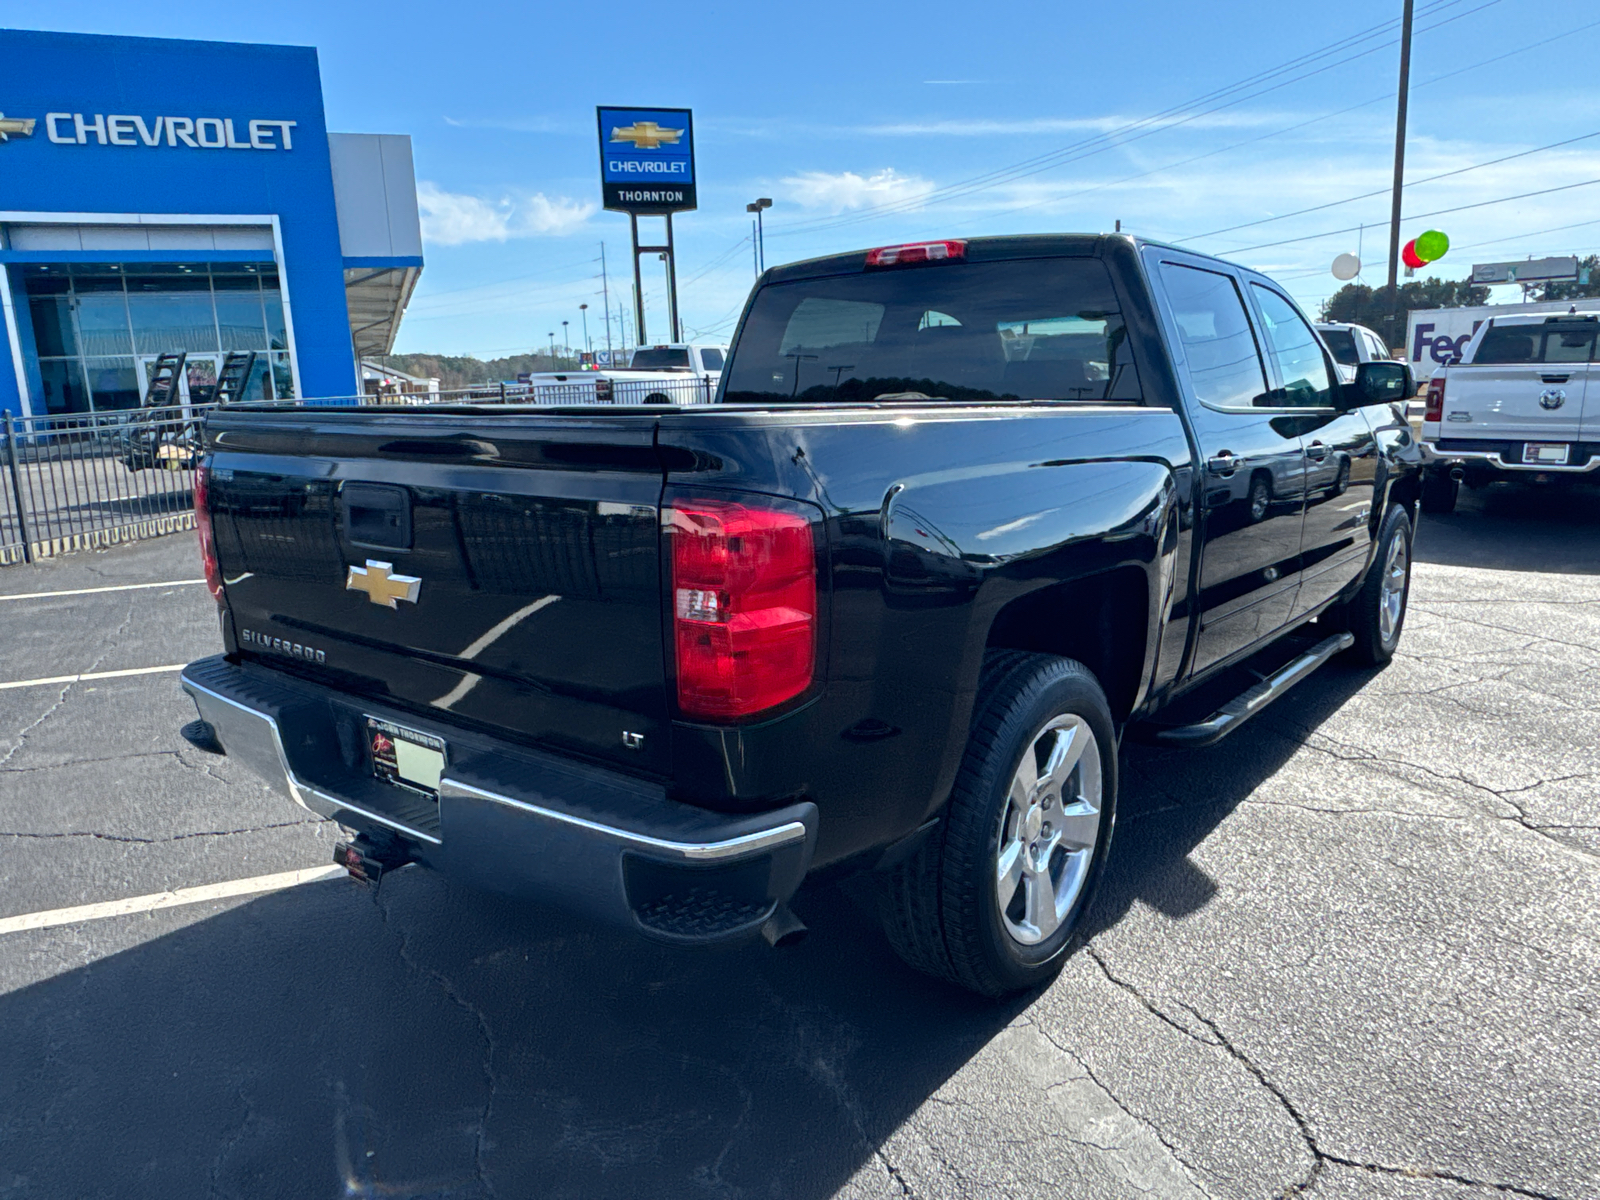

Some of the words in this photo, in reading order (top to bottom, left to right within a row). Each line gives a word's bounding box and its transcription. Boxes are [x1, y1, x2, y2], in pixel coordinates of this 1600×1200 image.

[46, 112, 297, 150] CHEVROLET
[609, 161, 686, 173] CHEVROLET
[618, 191, 683, 201] THORNTON
[242, 629, 326, 664] SILVERADO
[622, 731, 644, 749] LT
